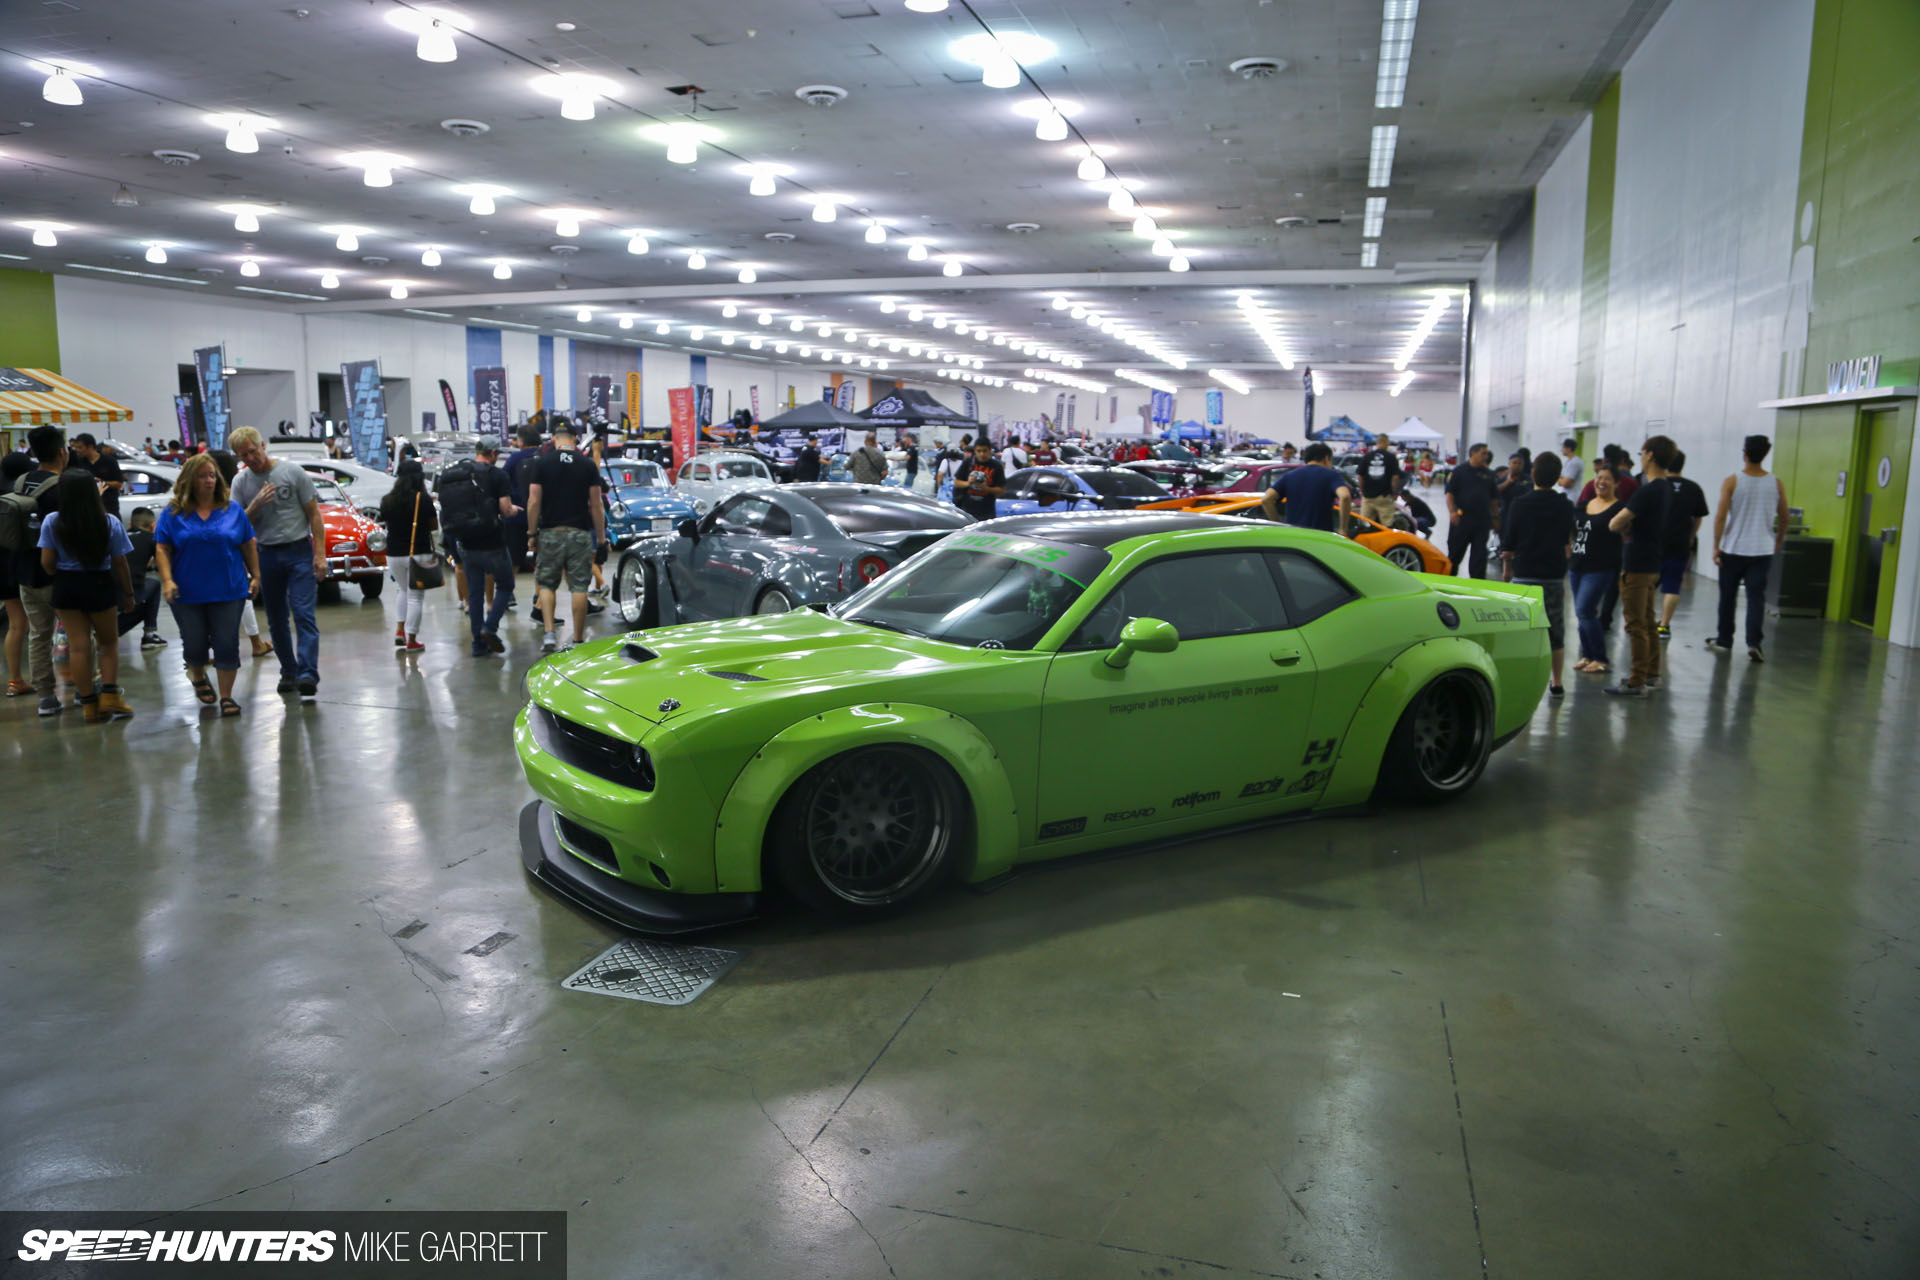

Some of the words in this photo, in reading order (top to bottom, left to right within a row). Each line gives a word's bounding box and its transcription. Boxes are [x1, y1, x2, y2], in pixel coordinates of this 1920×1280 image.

[1826, 354, 1881, 395] WOMEN
[1576, 519, 1592, 531] LA
[1577, 531, 1588, 542] DI
[1109, 703, 1146, 714] Imagine
[1148, 697, 1159, 708] all
[1161, 696, 1175, 706] the
[1177, 693, 1206, 706] people
[1171, 790, 1221, 809] rotiform
[1103, 807, 1156, 823] RECARO
